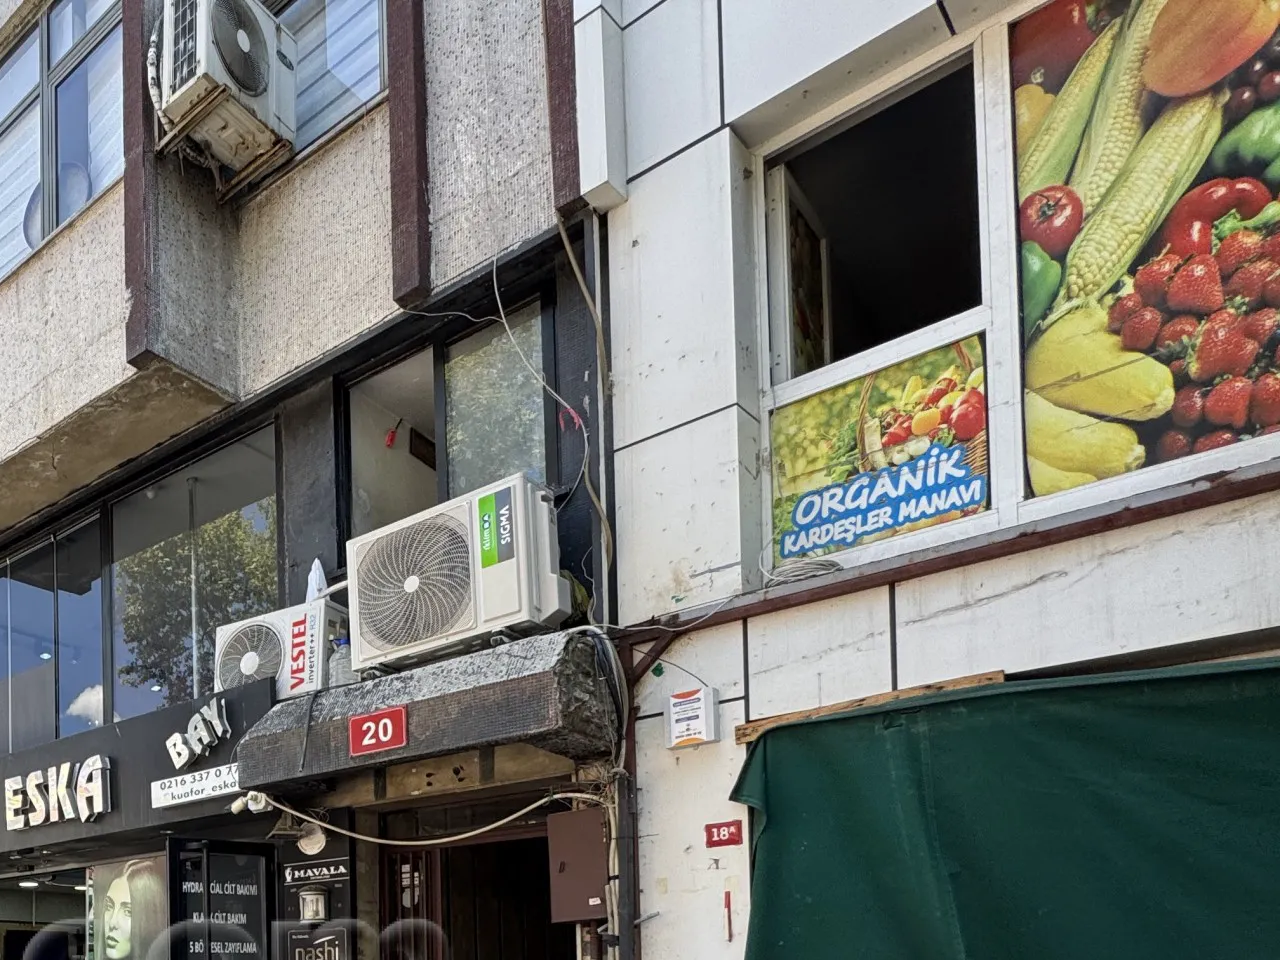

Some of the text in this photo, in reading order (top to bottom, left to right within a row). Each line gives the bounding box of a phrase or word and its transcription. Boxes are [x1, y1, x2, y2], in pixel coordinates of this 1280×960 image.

[784, 480, 982, 556] KARDEŞLER MANAVI
[796, 447, 966, 525] ORGANİK
[499, 504, 511, 545] SIGMA
[290, 613, 307, 691] VESTEL
[165, 697, 228, 770] BAY
[361, 718, 393, 746] 20
[4, 755, 111, 831] ESKA
[160, 778, 187, 791] 0216
[190, 771, 210, 784] 337
[294, 866, 347, 878] MAVALA
